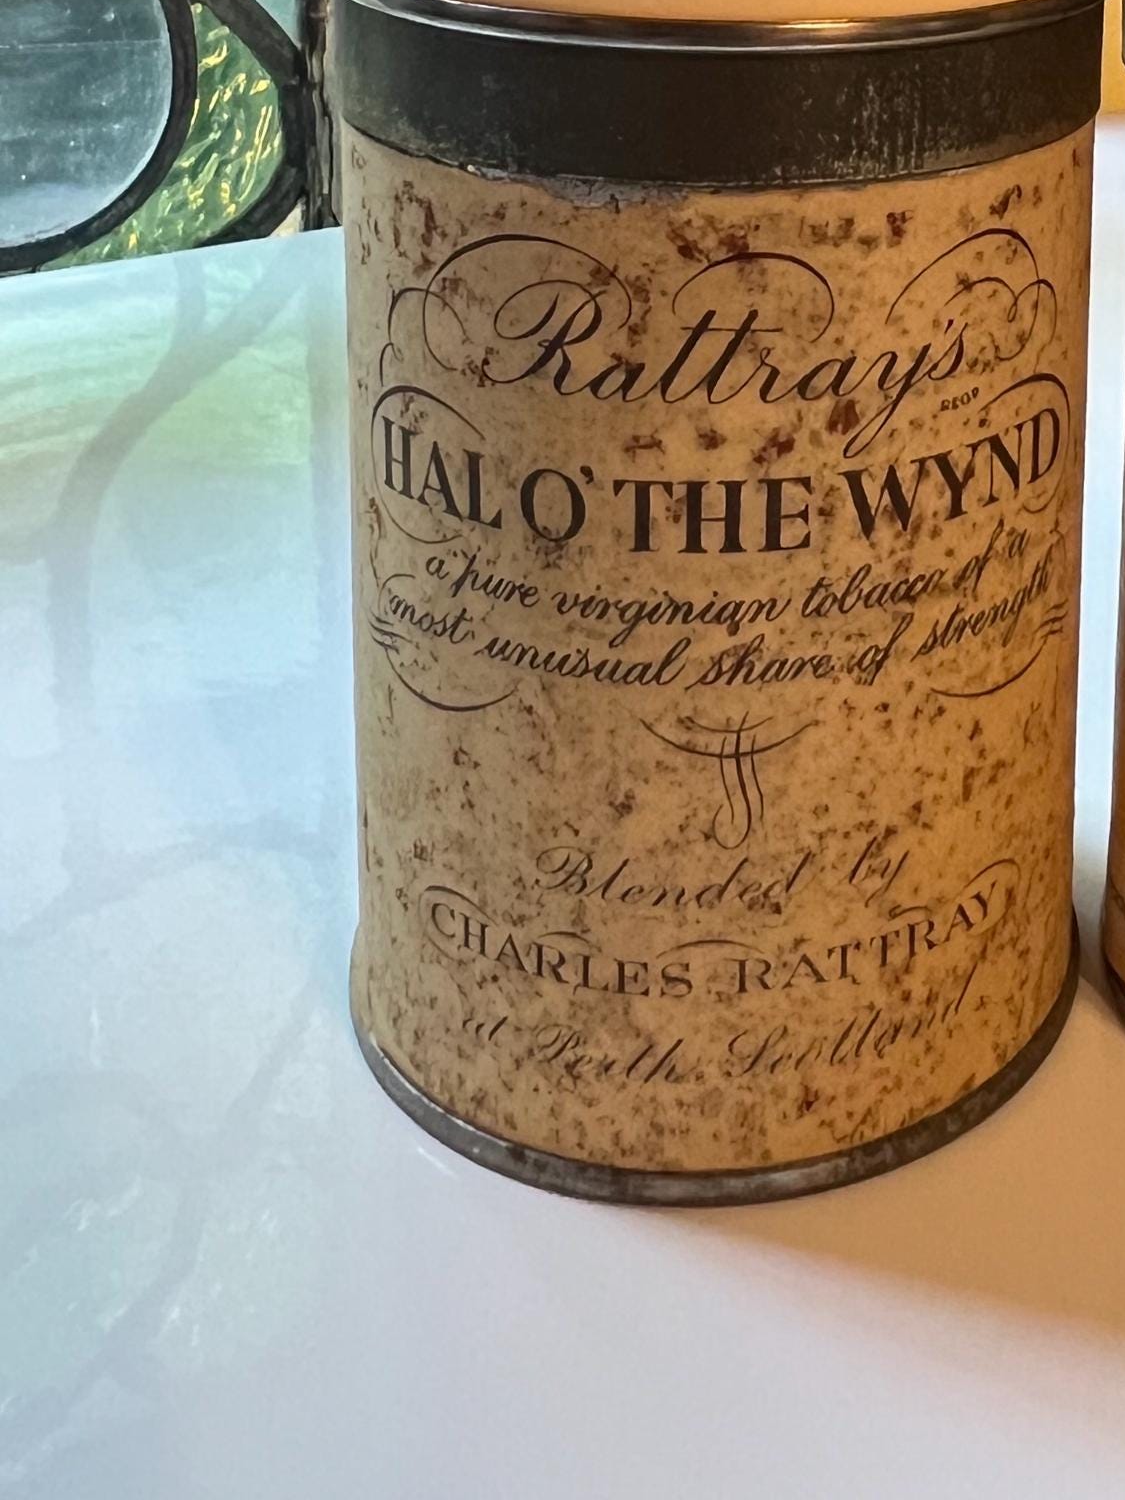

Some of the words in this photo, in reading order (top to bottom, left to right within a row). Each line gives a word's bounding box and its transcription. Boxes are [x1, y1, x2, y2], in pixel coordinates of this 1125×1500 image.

[481, 279, 968, 459] Rattray's
[380, 416, 502, 531] HAL
[520, 466, 596, 543] O'
[613, 477, 818, 555] THE
[842, 407, 1061, 542] WYND
[388, 593, 475, 644] most
[474, 636, 692, 687] unusual
[694, 635, 835, 693] share
[853, 611, 915, 686] of
[910, 542, 1055, 663] strength
[425, 554, 450, 581] a
[449, 546, 541, 608] pure
[550, 584, 788, 649] virginian
[801, 564, 949, 618] tobacco
[952, 517, 1005, 592] of
[1007, 528, 1030, 559] a
[533, 846, 818, 908] Blended
[848, 834, 911, 902] by
[428, 901, 694, 999] CHARLES
[737, 882, 1001, 995] RATTRAY
[725, 965, 979, 1079] Scotland
